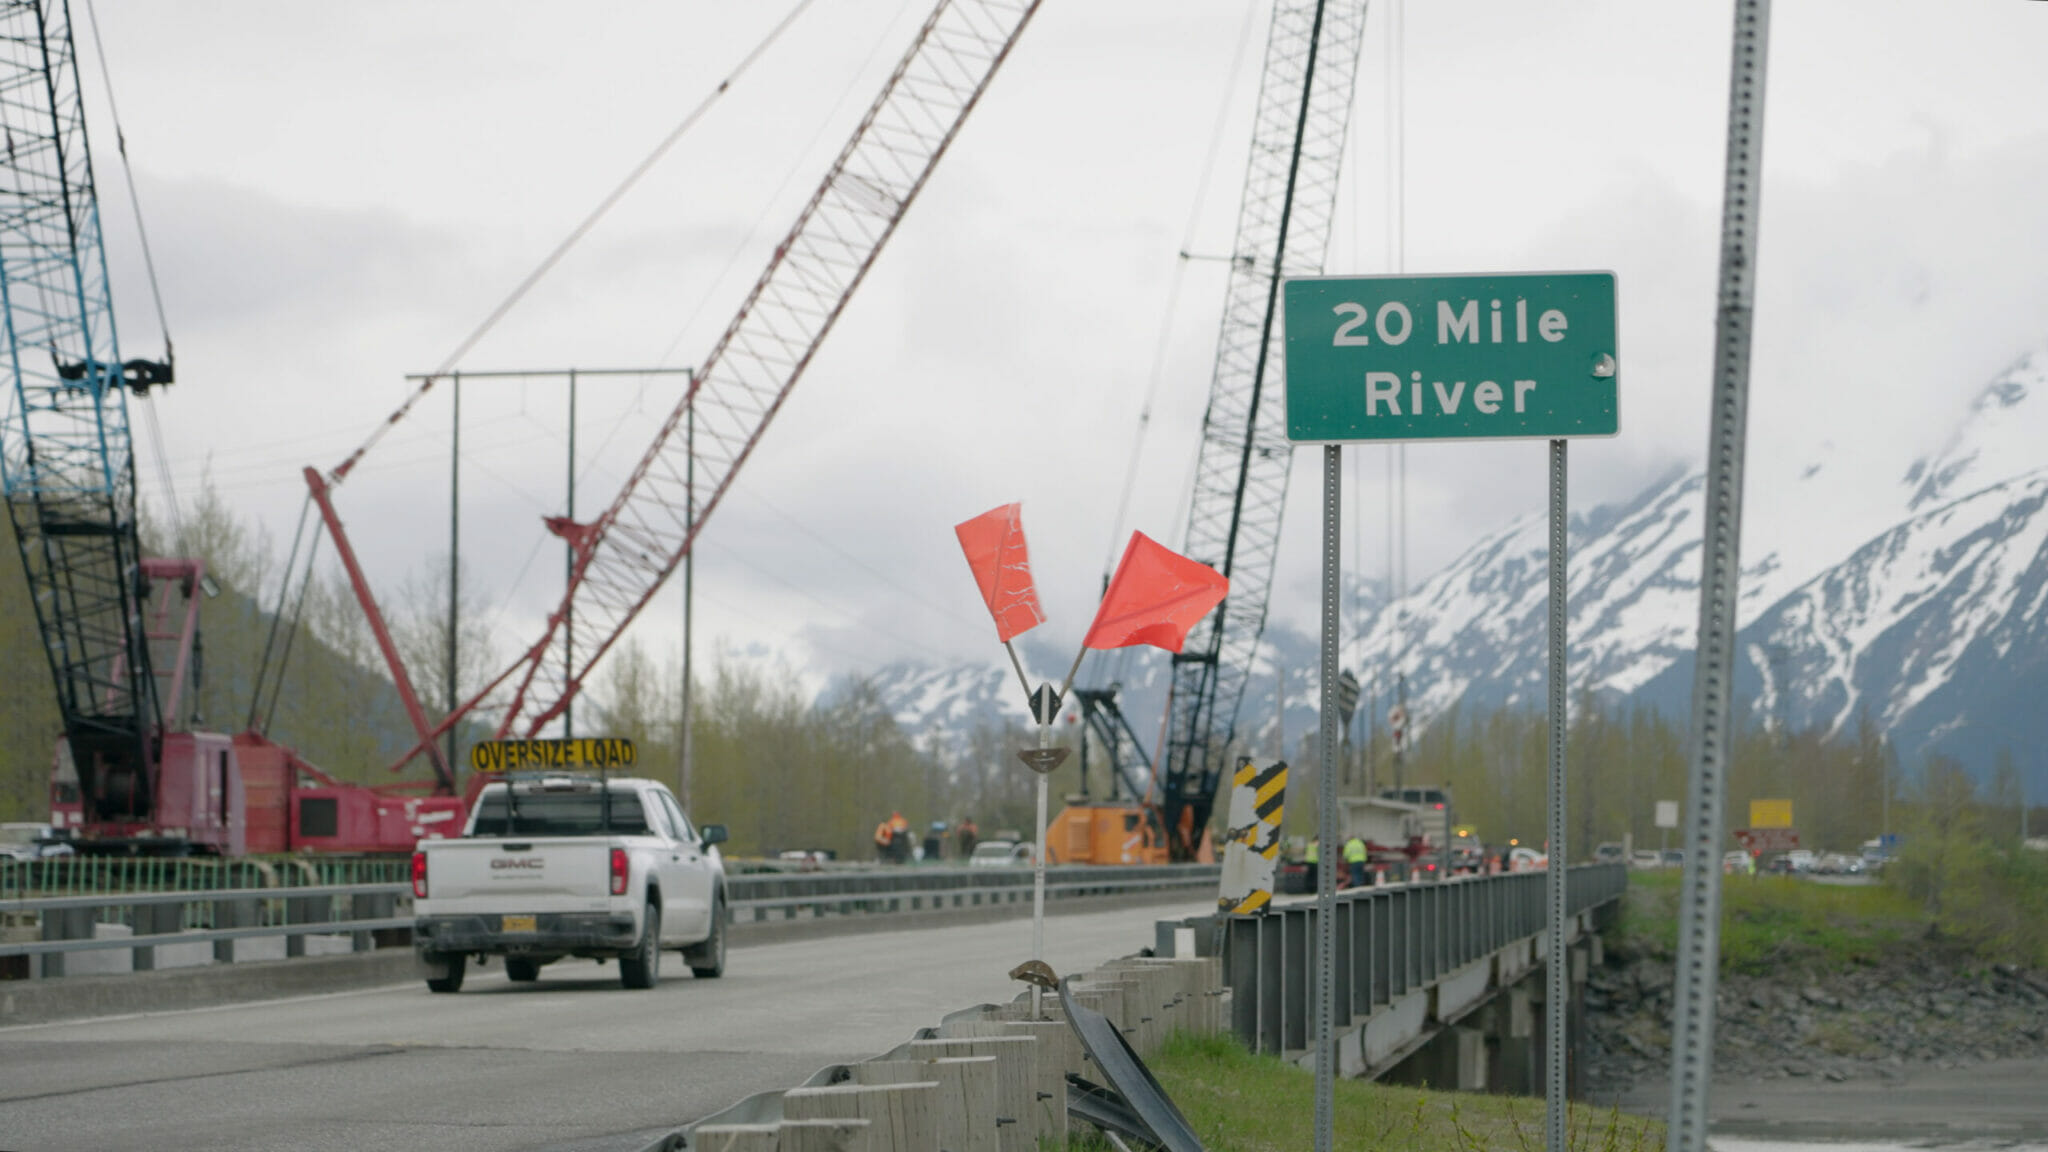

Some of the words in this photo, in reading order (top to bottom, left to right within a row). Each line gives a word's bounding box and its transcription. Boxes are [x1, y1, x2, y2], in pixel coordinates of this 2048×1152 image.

[1332, 301, 1413, 347] 20
[1437, 299, 1569, 344] Mile
[1365, 371, 1537, 416] River
[476, 739, 575, 769] OVERSIZE
[582, 738, 634, 766] LOAD
[490, 858, 545, 869] GMC
